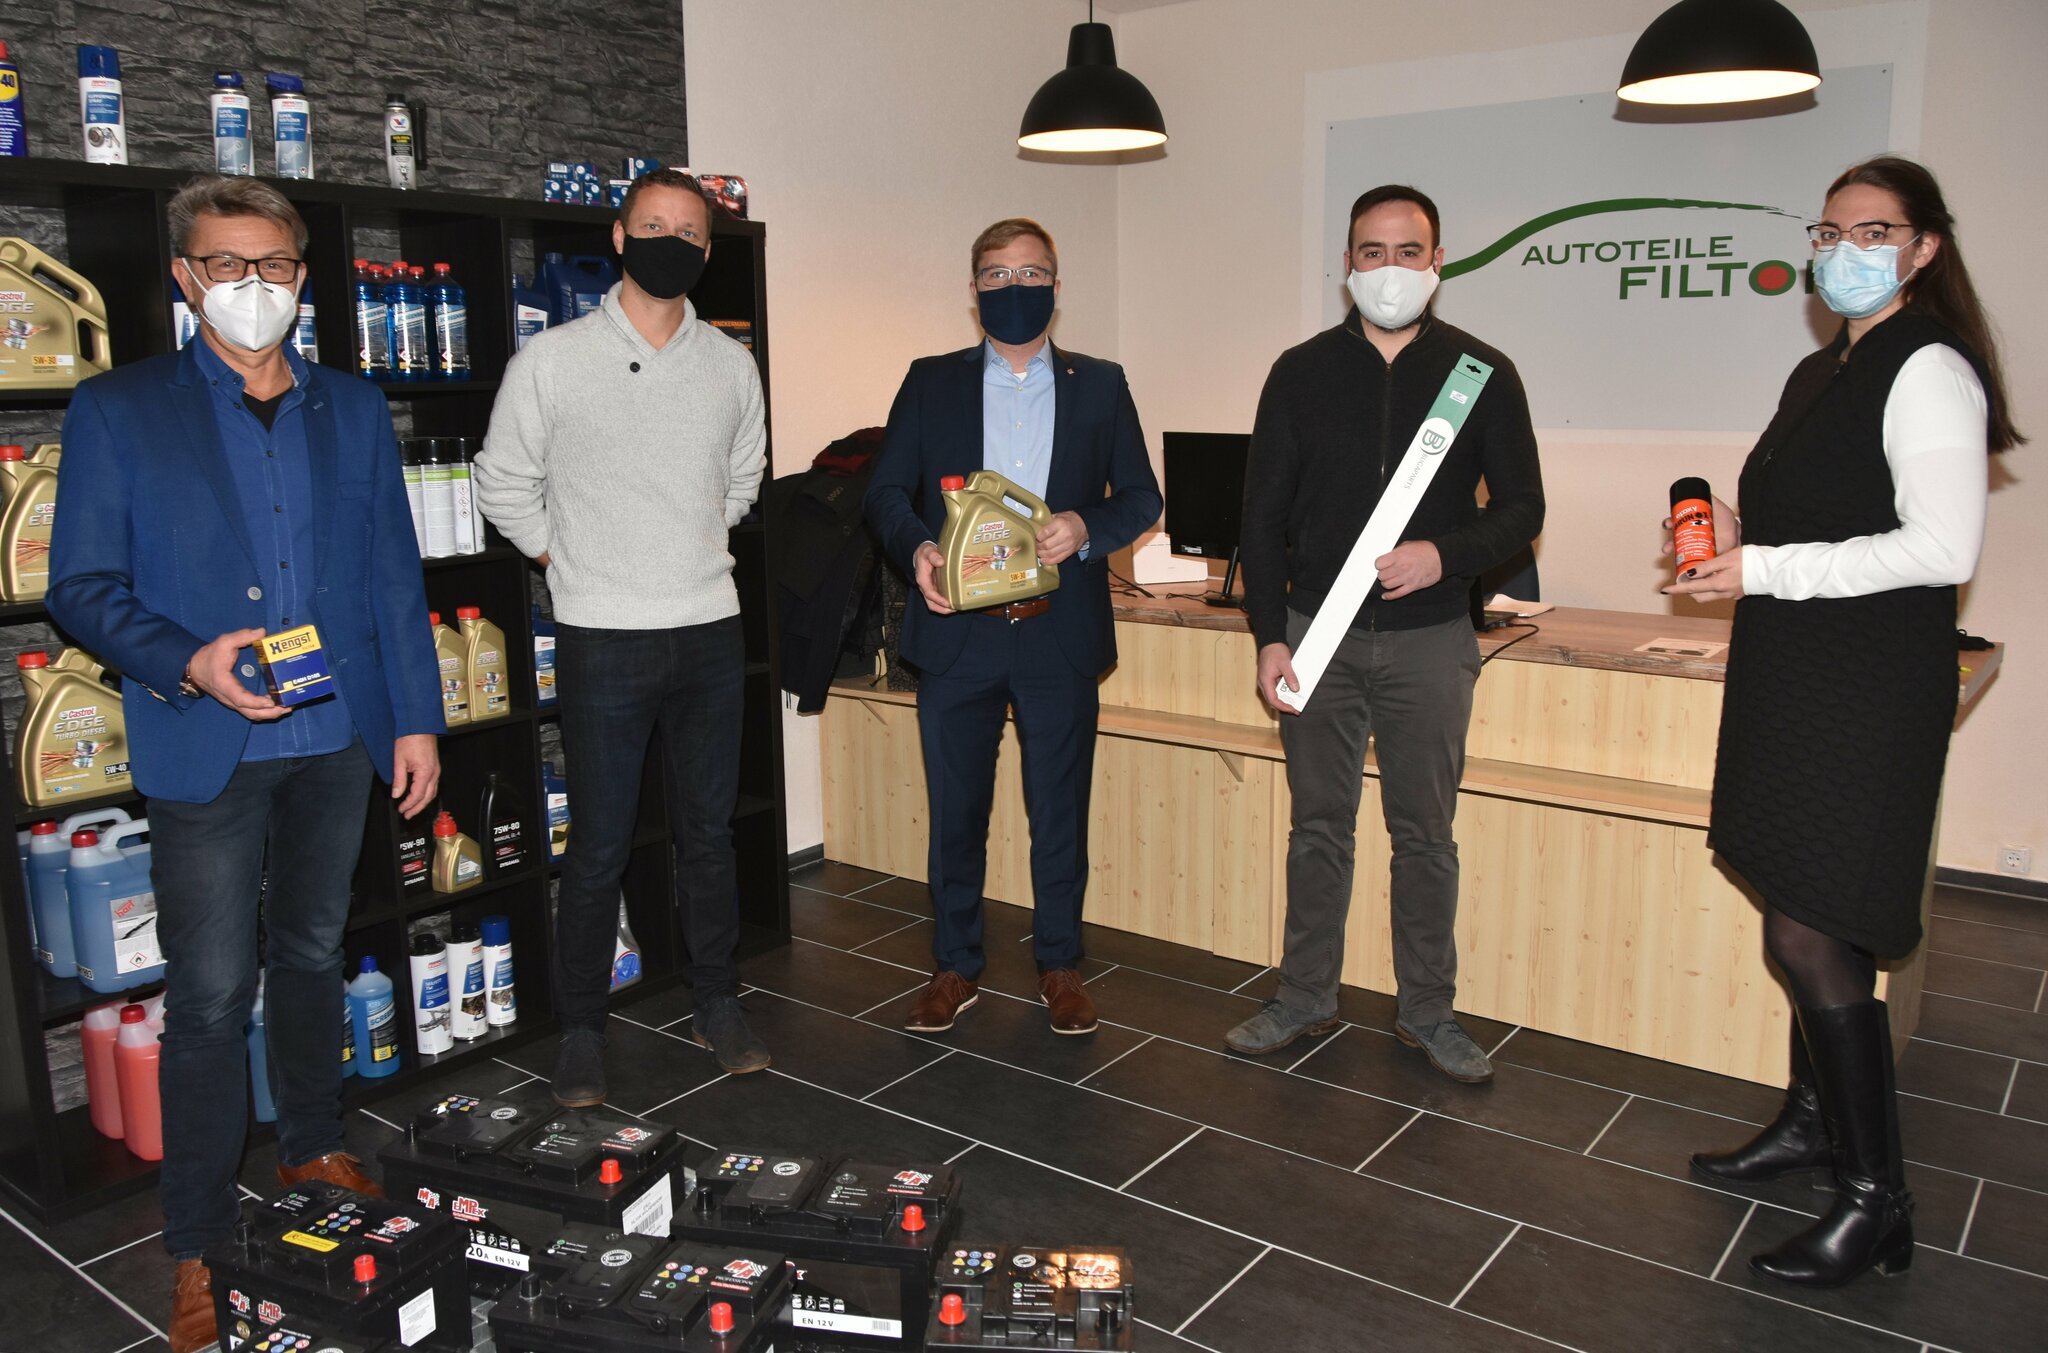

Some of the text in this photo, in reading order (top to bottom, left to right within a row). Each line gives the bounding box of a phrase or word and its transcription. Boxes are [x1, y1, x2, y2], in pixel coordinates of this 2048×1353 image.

[1521, 235, 1734, 266] AUTOTEILE
[1619, 259, 1815, 300] FILTO
[983, 522, 1003, 532] Castrol
[972, 529, 1011, 545] EDGE
[1010, 572, 1026, 581] 5W-30
[270, 632, 311, 654] Hengst
[69, 708, 94, 718] Castrol
[54, 716, 105, 733] EDGE
[55, 726, 106, 741] TURBO DIESEL
[105, 764, 126, 774] 5W-40
[494, 822, 520, 835] 75W-80
[495, 1255, 505, 1263] EN
[802, 1317, 814, 1325] EN
